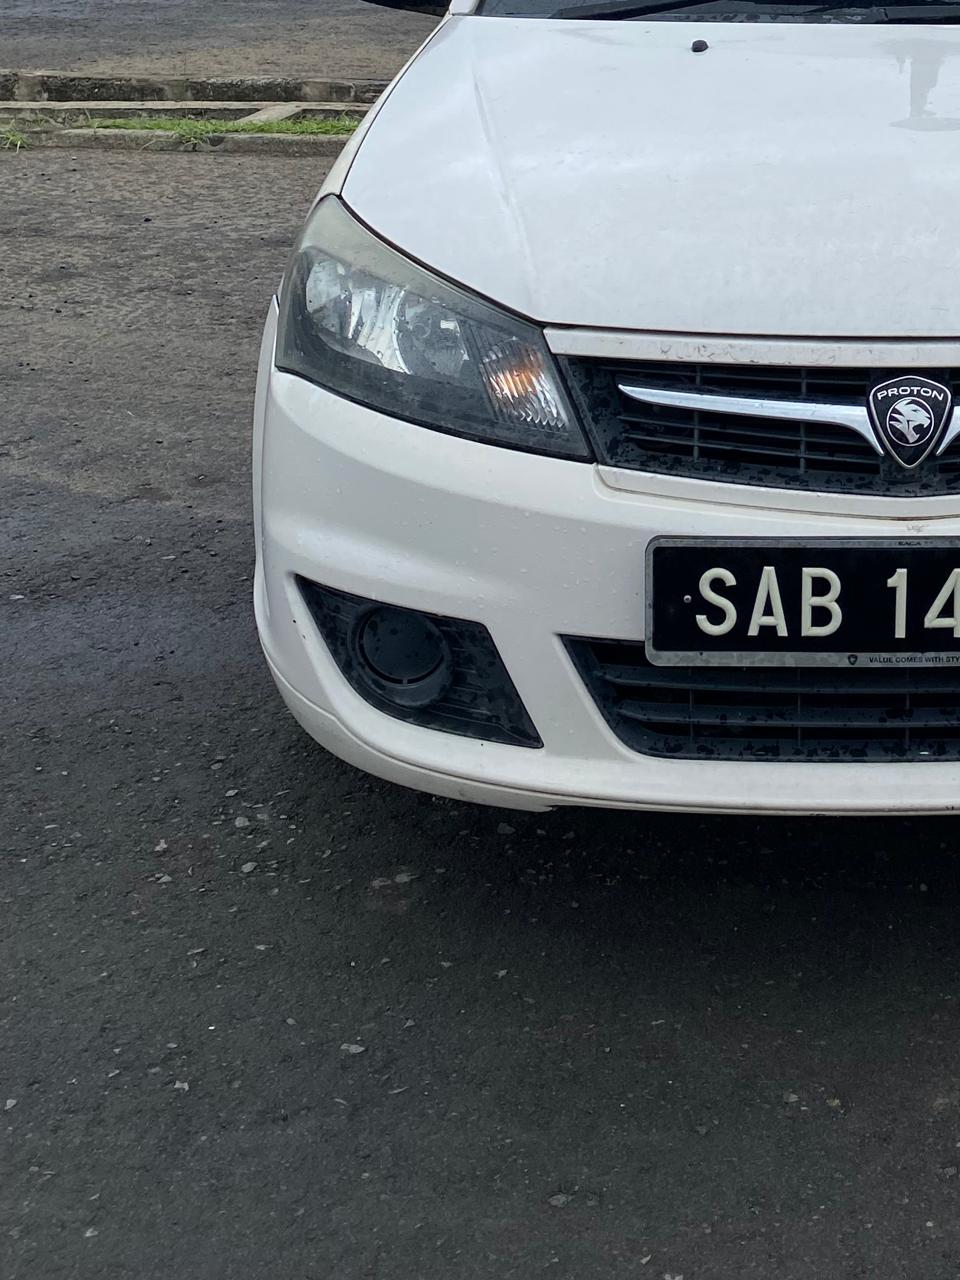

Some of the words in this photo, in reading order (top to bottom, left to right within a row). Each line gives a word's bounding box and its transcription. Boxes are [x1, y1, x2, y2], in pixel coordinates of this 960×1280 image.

[876, 386, 944, 401] PROTON
[695, 565, 843, 638] SAB
[868, 656, 893, 664] VALUE
[895, 656, 923, 664] COMES
